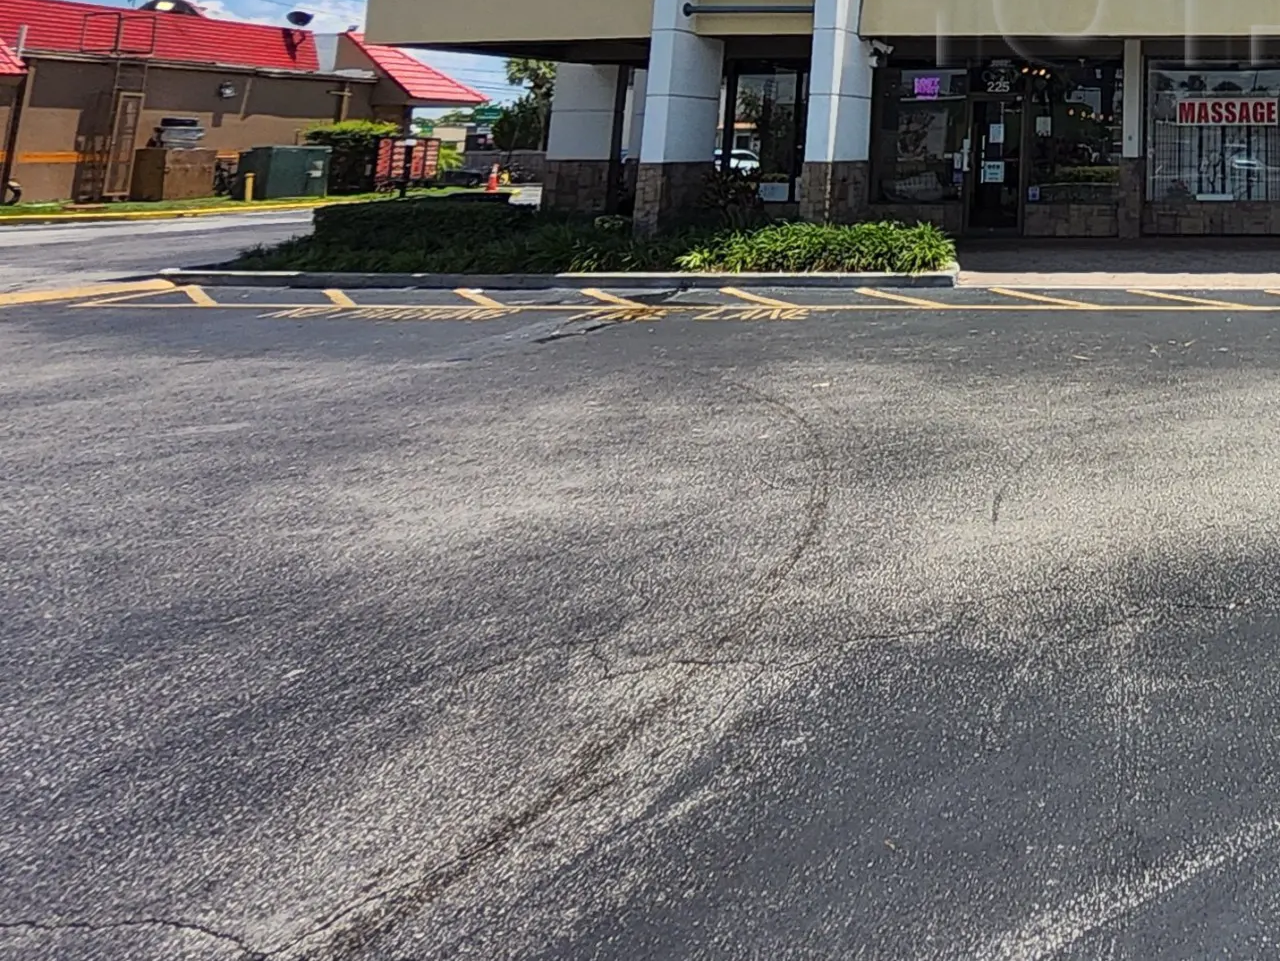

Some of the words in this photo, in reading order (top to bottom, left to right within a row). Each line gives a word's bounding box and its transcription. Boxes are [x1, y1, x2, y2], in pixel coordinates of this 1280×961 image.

[986, 80, 1011, 93] 225
[1178, 101, 1276, 124] MASSAGE
[692, 306, 824, 321] LANE
